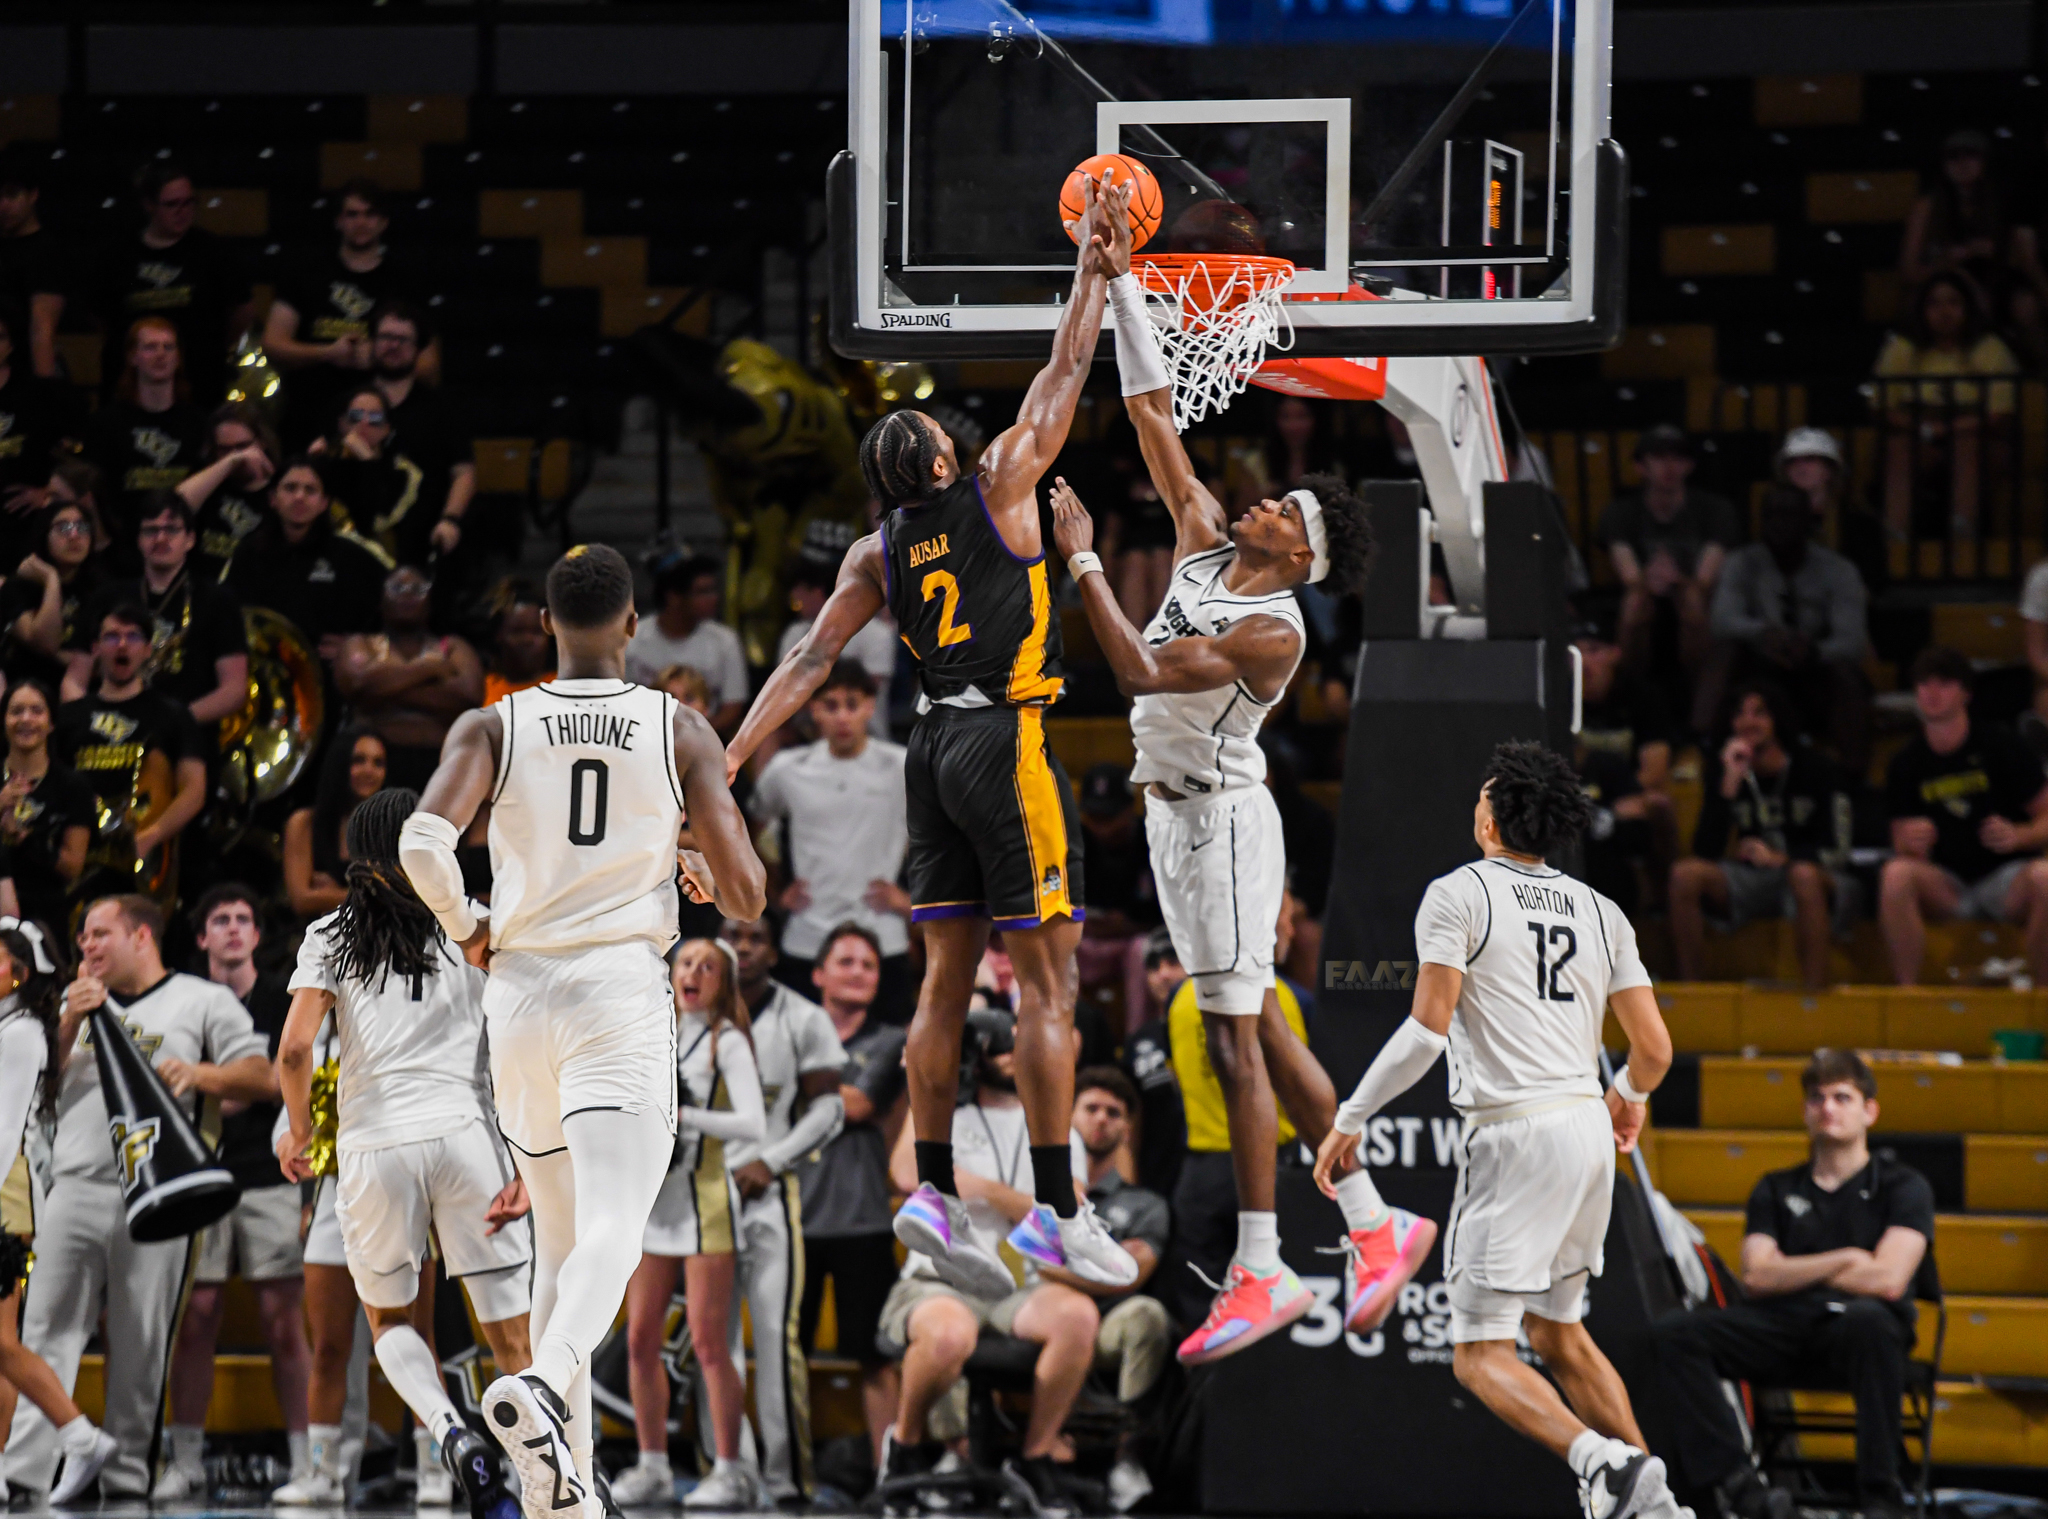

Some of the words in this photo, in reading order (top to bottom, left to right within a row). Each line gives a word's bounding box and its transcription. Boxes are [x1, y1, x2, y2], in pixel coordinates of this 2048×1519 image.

[881, 312, 953, 329] SPALDING
[909, 533, 951, 569] AUSAR
[920, 569, 977, 649] 2
[539, 713, 641, 752] THIOUNE
[568, 758, 608, 846] 0
[1511, 883, 1575, 919] HORTON
[1527, 920, 1577, 1002] 12
